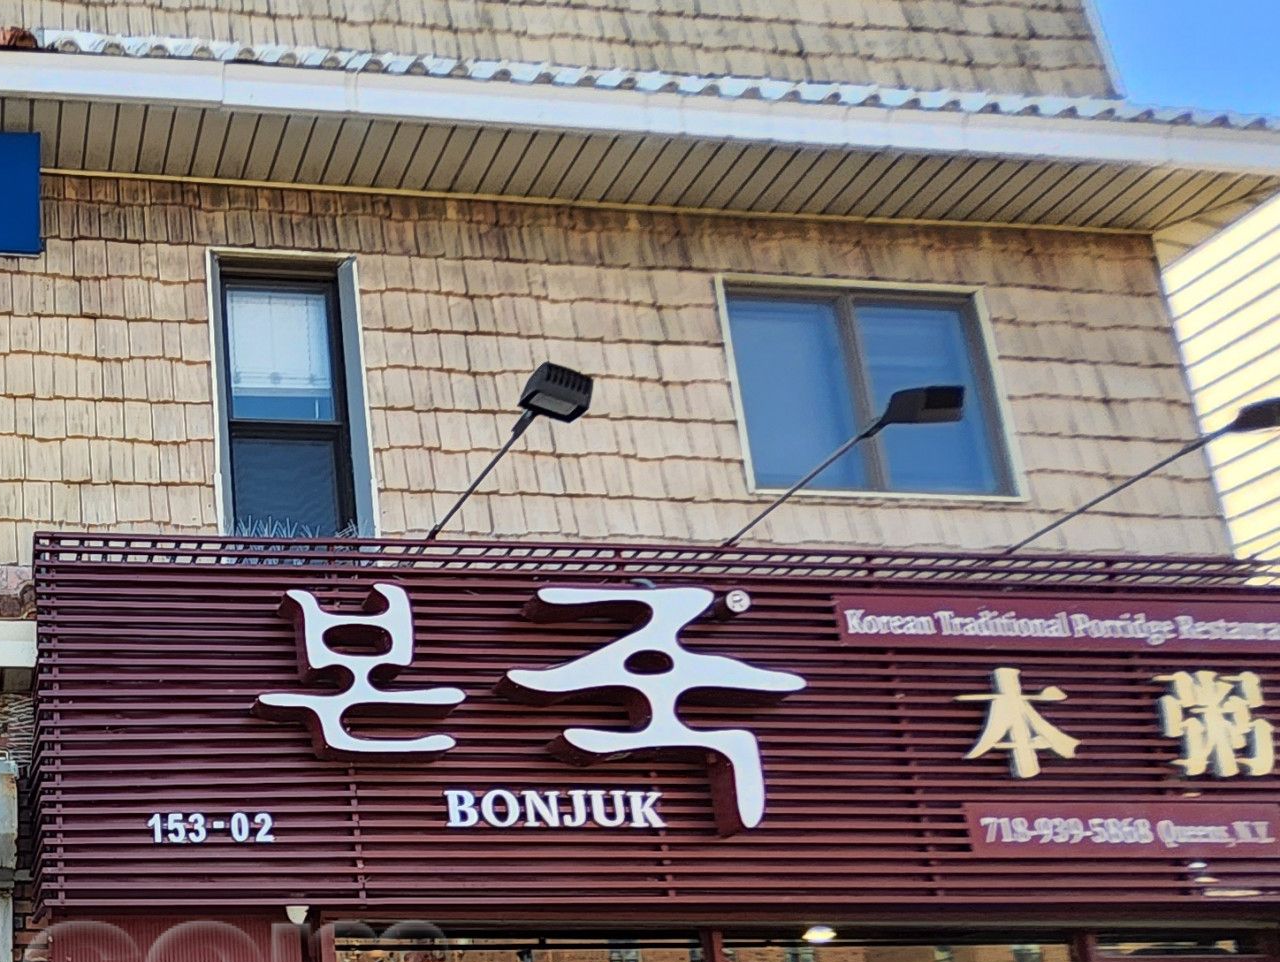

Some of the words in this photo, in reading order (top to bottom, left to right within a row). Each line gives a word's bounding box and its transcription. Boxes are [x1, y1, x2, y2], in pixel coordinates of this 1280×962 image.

[844, 609, 937, 635] Korean
[933, 607, 1072, 638] Traditional
[258, 582, 808, 830] 본죽
[445, 789, 668, 829] BONJUK
[147, 811, 276, 844] 153-02
